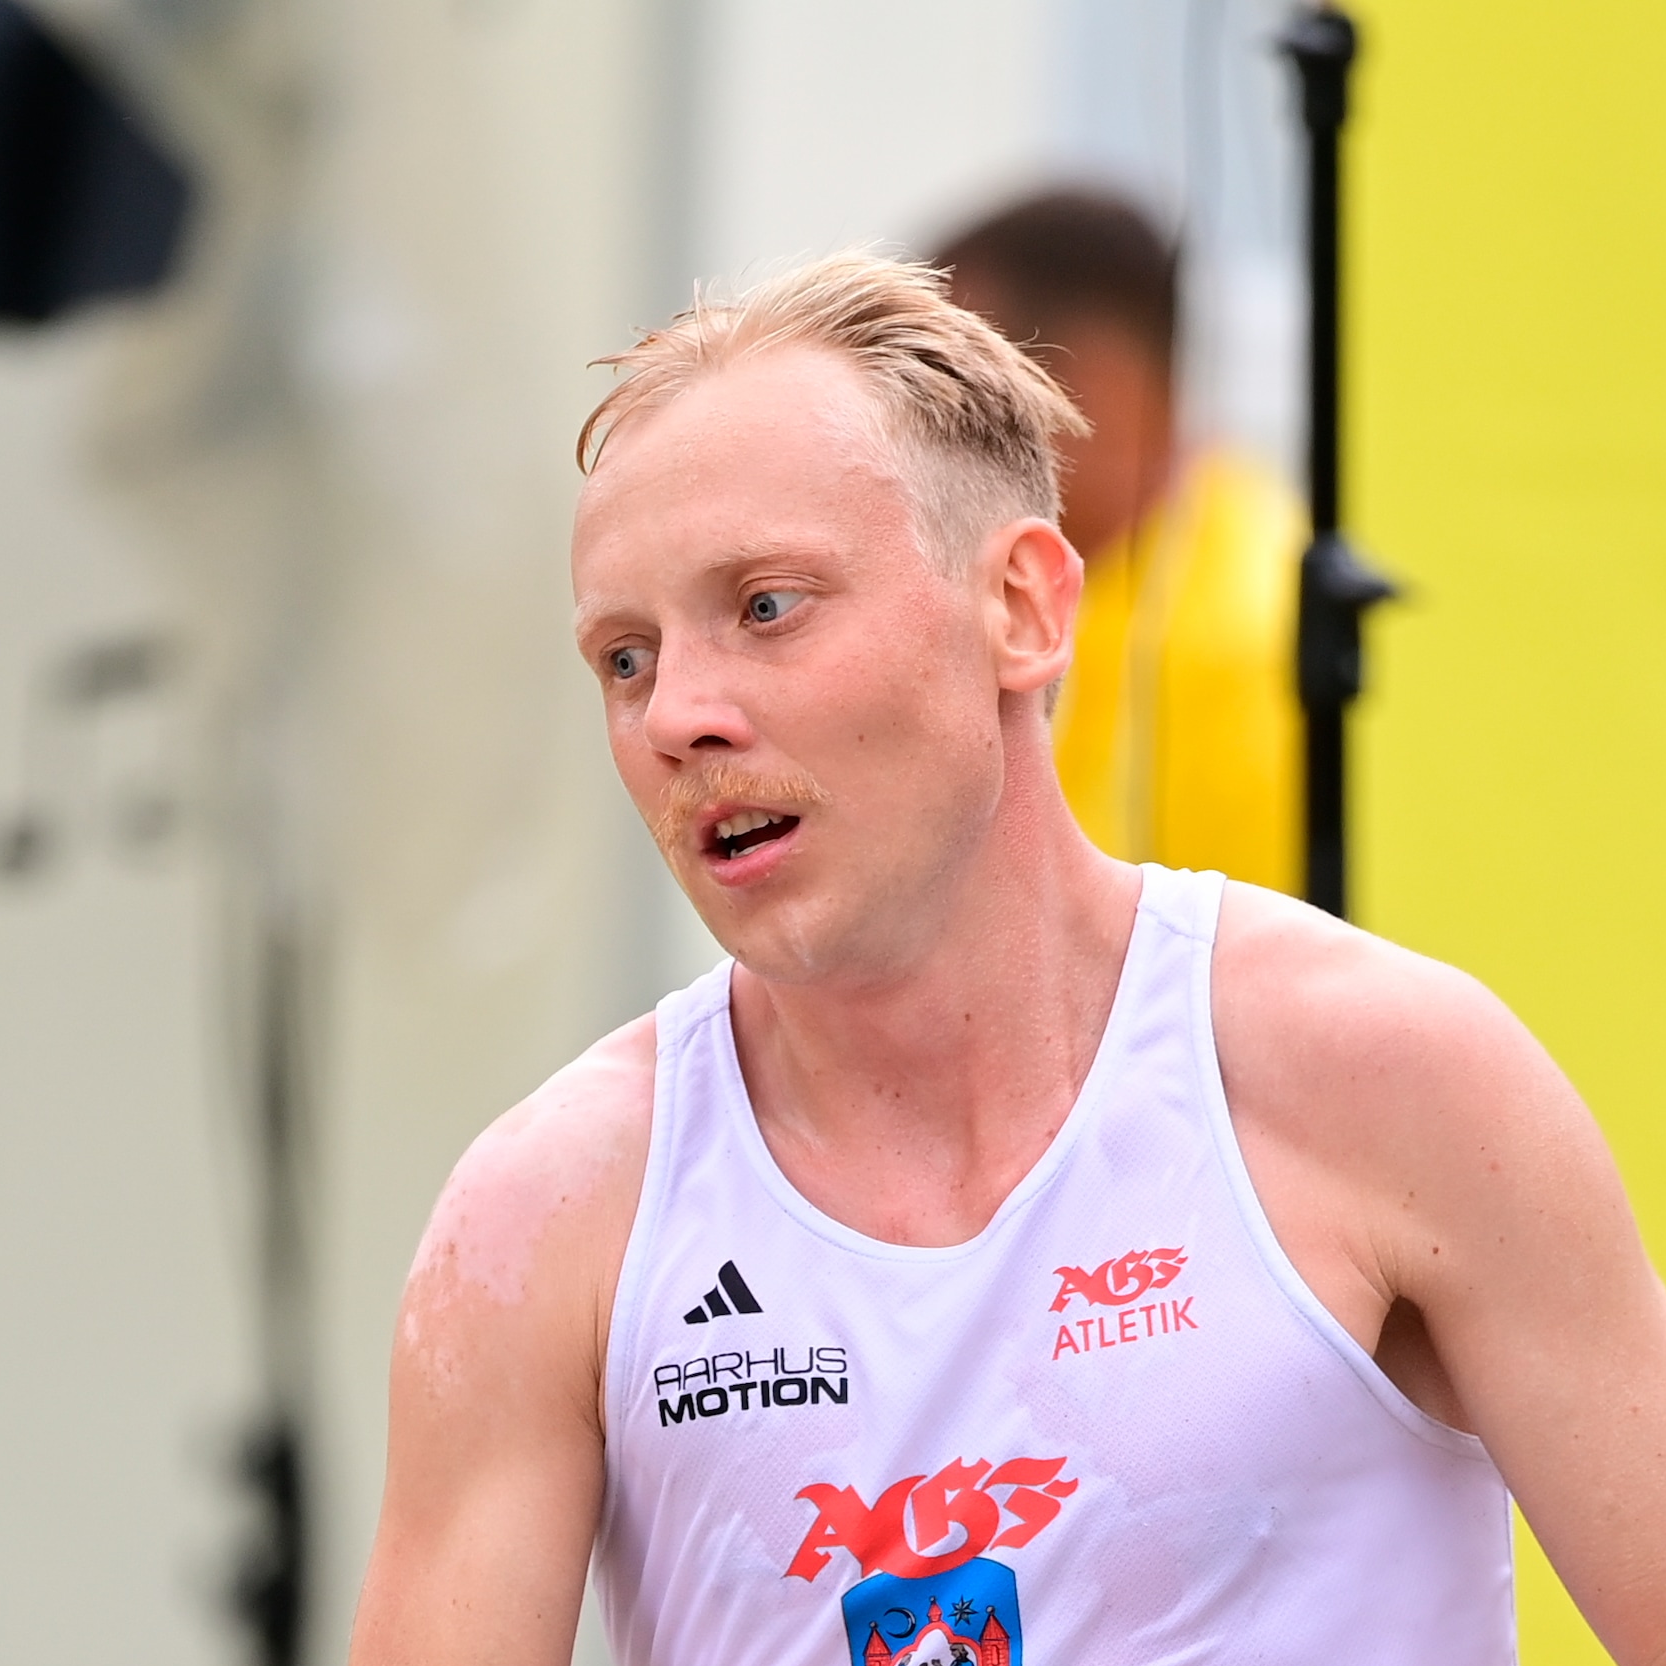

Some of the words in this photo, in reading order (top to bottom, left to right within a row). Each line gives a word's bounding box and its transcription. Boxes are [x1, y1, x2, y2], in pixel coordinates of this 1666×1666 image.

[1052, 1296, 1199, 1361] ATLETIK
[654, 1346, 848, 1395] AARHUS
[658, 1376, 849, 1427] MOTION
